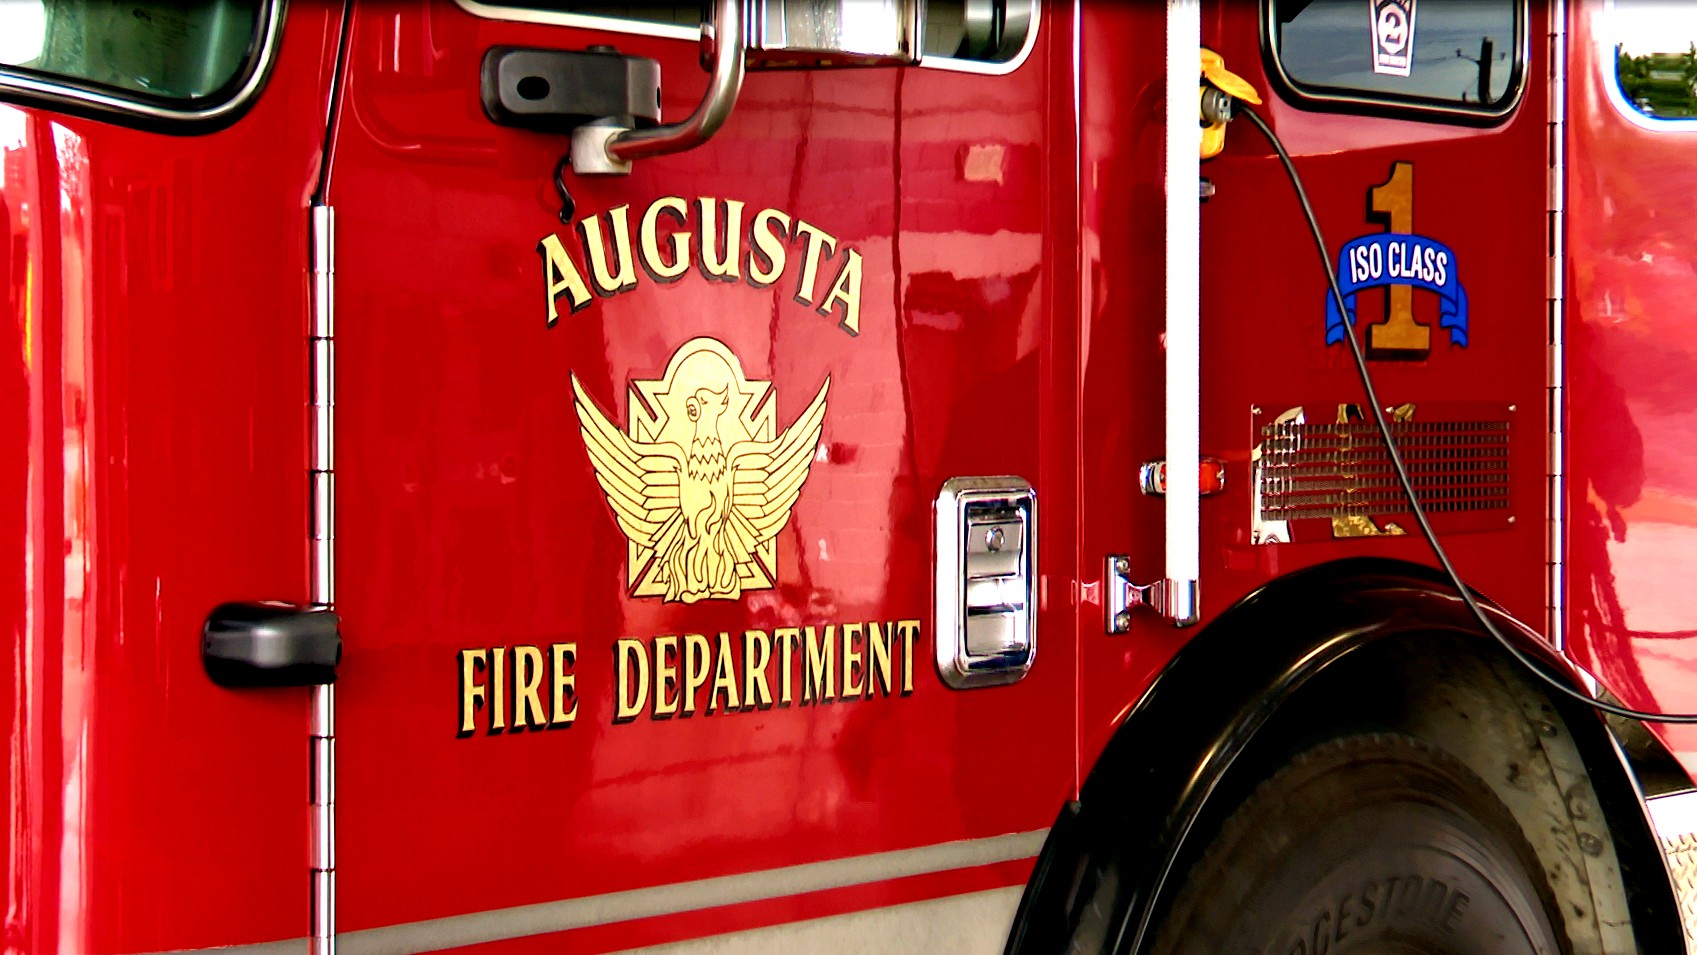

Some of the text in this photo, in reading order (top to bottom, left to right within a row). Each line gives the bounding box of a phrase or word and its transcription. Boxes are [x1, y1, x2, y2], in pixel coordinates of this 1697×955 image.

[1384, 12, 1401, 45] 2
[537, 196, 863, 335] AUGUSTA
[1349, 241, 1448, 286] ISO CLASS
[1367, 161, 1430, 359] 1
[457, 619, 921, 738] FIRE DEPARTMENT
